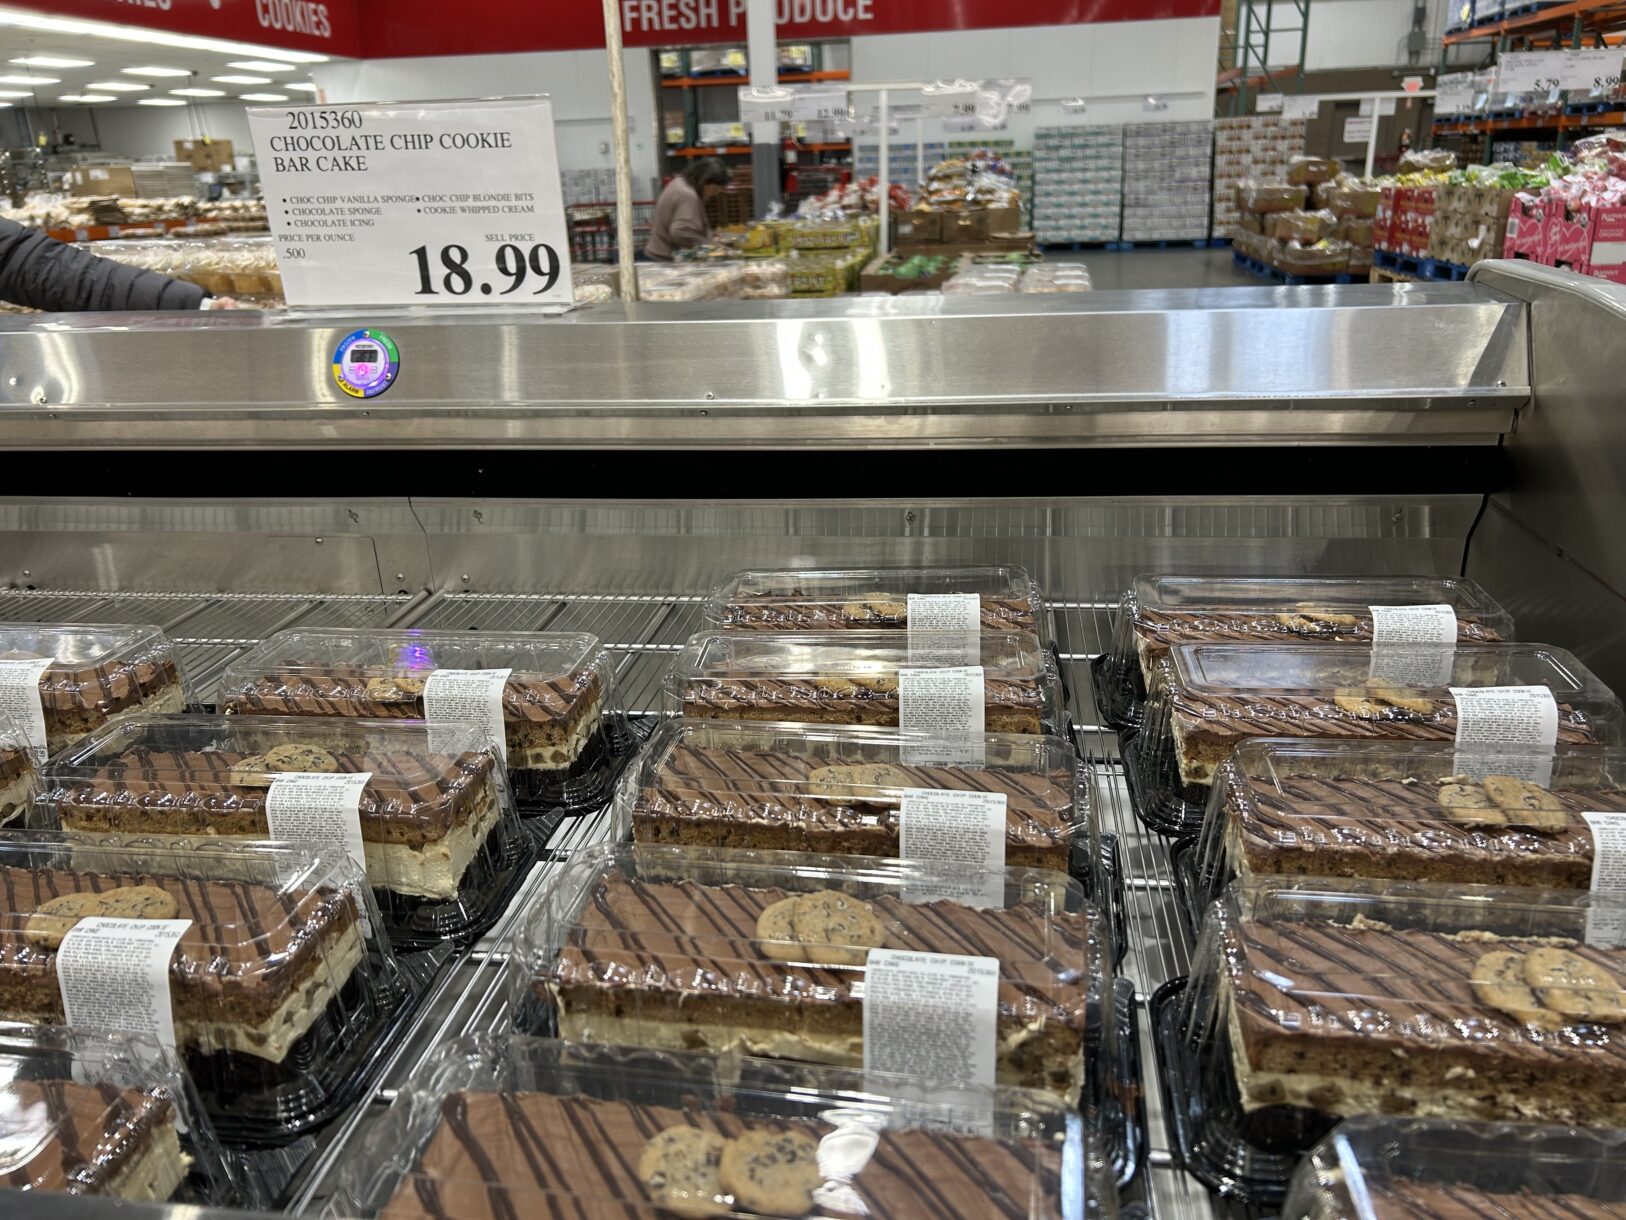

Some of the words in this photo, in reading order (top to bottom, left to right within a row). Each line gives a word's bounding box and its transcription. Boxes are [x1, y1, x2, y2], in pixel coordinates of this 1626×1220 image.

[256, 0, 332, 38] COOKIES
[624, 0, 719, 32] FRESH
[730, 0, 874, 26] PODUCE
[287, 111, 363, 129] 2015360
[270, 134, 385, 151] CHOCOLATE
[390, 134, 434, 150] CHIP
[440, 132, 512, 150] COOKIE
[274, 157, 312, 172] BAR
[316, 156, 368, 172] CAKE
[290, 196, 315, 204] CHOC
[316, 196, 338, 204] CHIP
[340, 196, 379, 204] VANILLA
[381, 195, 416, 204] SPONGE
[422, 195, 447, 203] CHOC
[450, 194, 471, 203] CHIP
[473, 194, 512, 202] BLONDIE
[514, 193, 534, 201] BITS
[292, 208, 346, 216] CHOCOLATE
[348, 207, 383, 216] SPONGE
[424, 206, 458, 215] COOKIE
[460, 206, 500, 214] WHIPPED
[502, 205, 534, 214] CREAM
[350, 219, 375, 227] ICING
[278, 234, 304, 242] PRICE
[306, 234, 322, 242] PER
[324, 233, 355, 242] OUNCE
[485, 234, 507, 242] SELL
[509, 234, 535, 242] PRICE
[283, 248, 306, 259] .500
[409, 244, 560, 295] 18.99
[343, 382, 360, 394] ALARM
